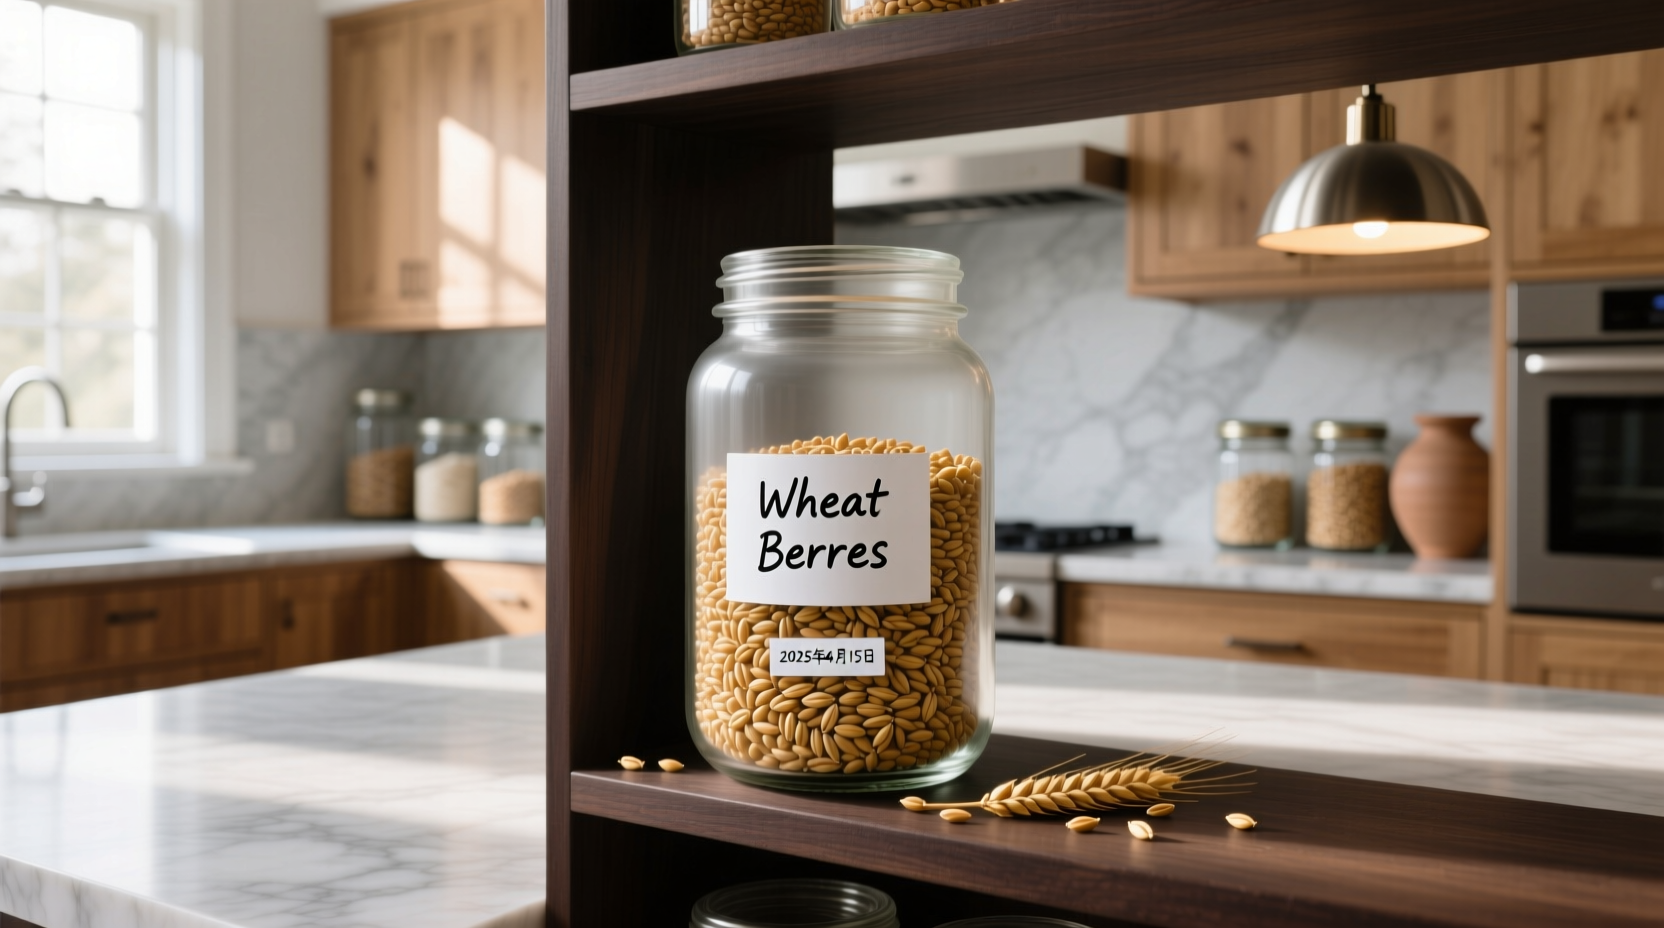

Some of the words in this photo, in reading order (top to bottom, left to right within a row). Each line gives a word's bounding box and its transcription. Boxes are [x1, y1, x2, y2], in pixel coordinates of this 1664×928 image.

[760, 476, 889, 518] Wheat
[758, 530, 888, 572] Berres
[779, 648, 874, 665] 2025年4月15日
